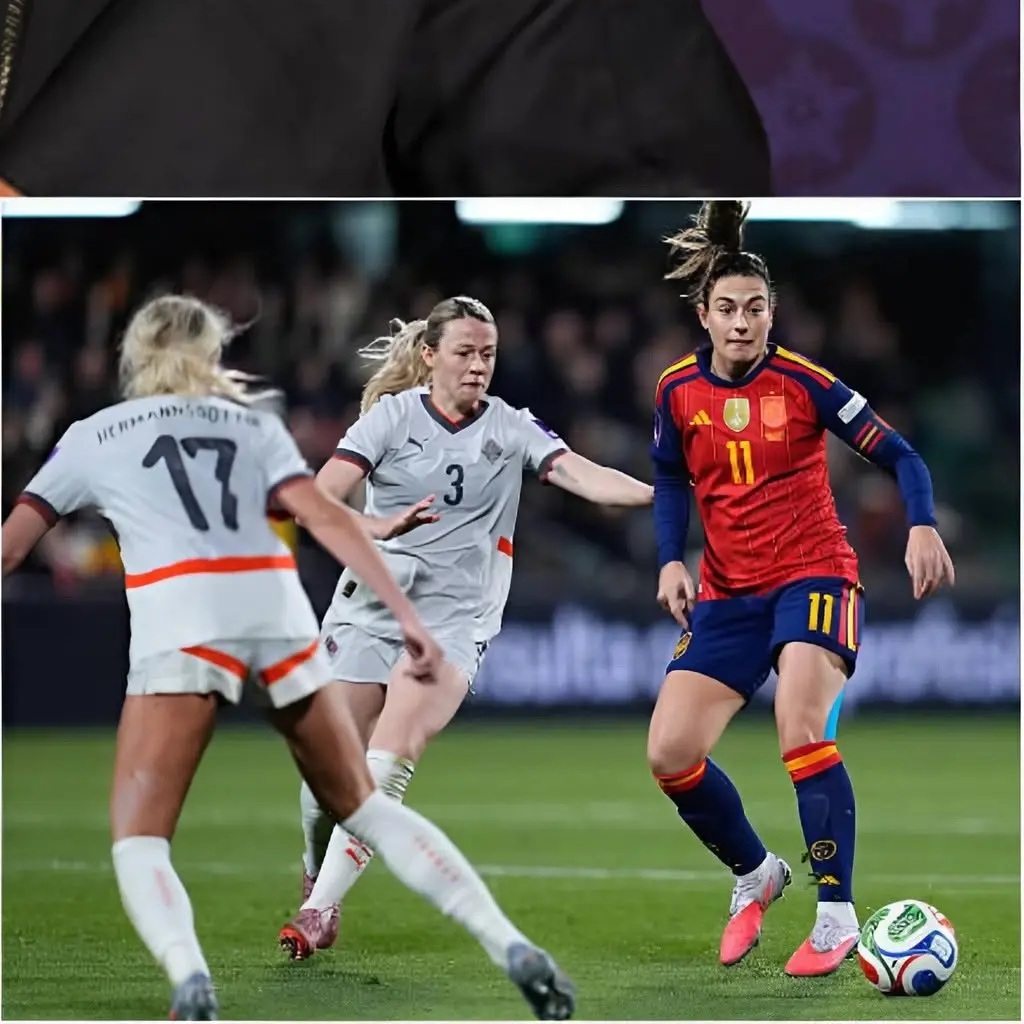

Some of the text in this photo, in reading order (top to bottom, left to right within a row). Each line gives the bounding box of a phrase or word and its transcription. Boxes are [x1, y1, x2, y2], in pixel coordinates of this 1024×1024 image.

[142, 434, 240, 532] 17
[443, 463, 465, 506] 3
[726, 440, 755, 485] 11
[808, 592, 834, 635] 11
